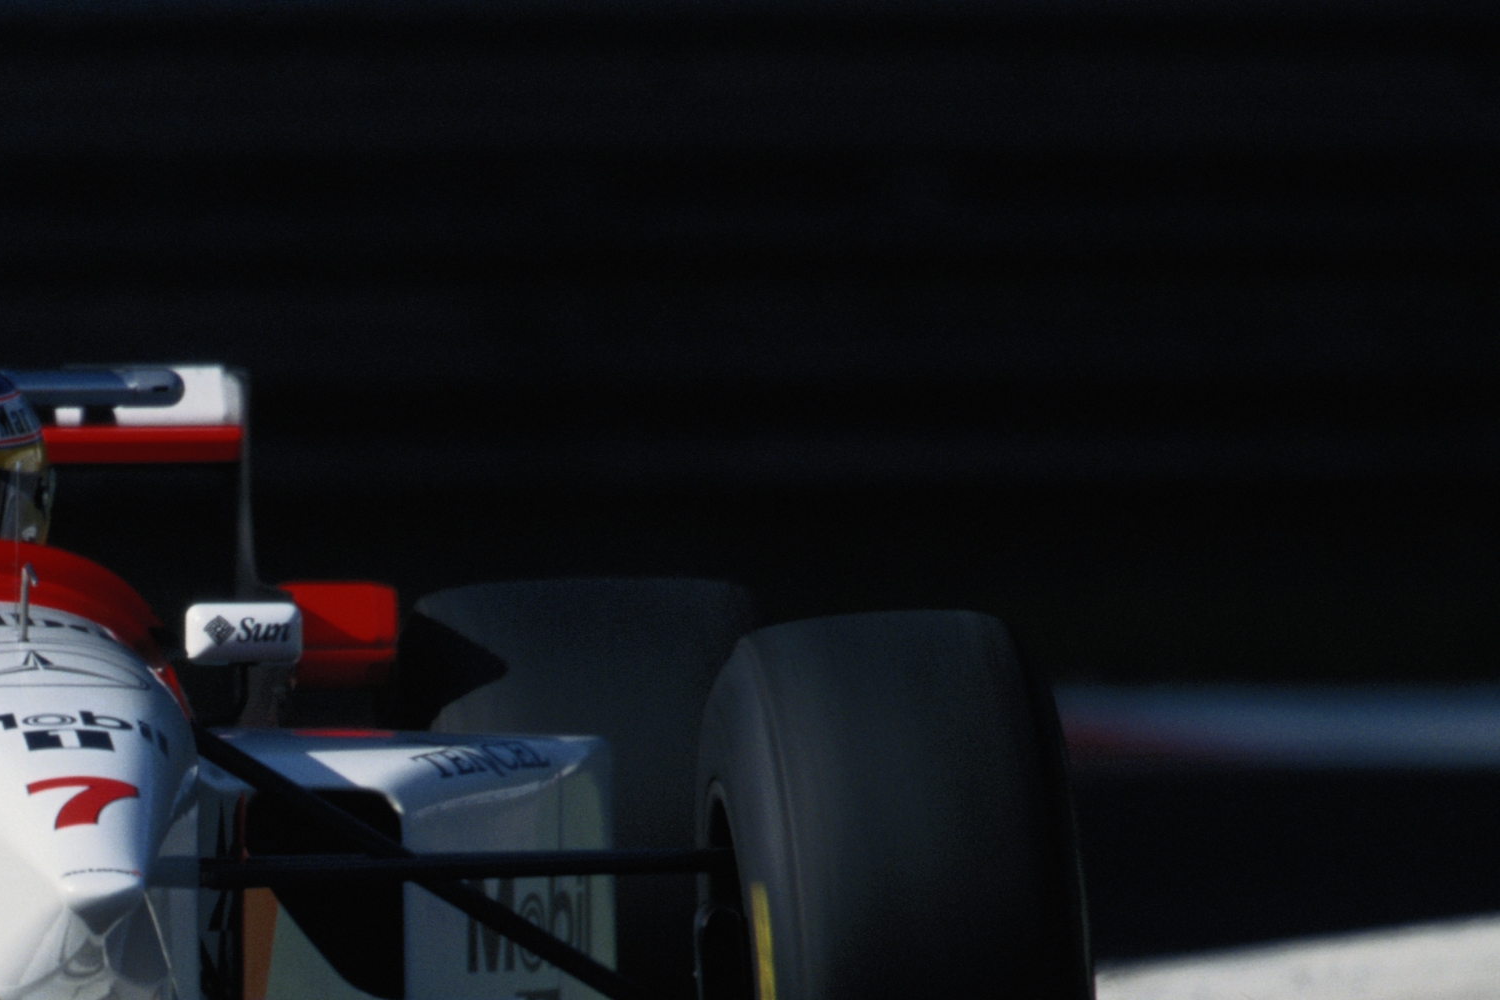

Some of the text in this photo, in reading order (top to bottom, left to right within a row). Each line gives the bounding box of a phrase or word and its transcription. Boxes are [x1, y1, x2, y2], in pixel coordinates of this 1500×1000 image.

[235, 617, 290, 643] Sun
[410, 741, 550, 779] TENCEL
[26, 775, 140, 830] 7
